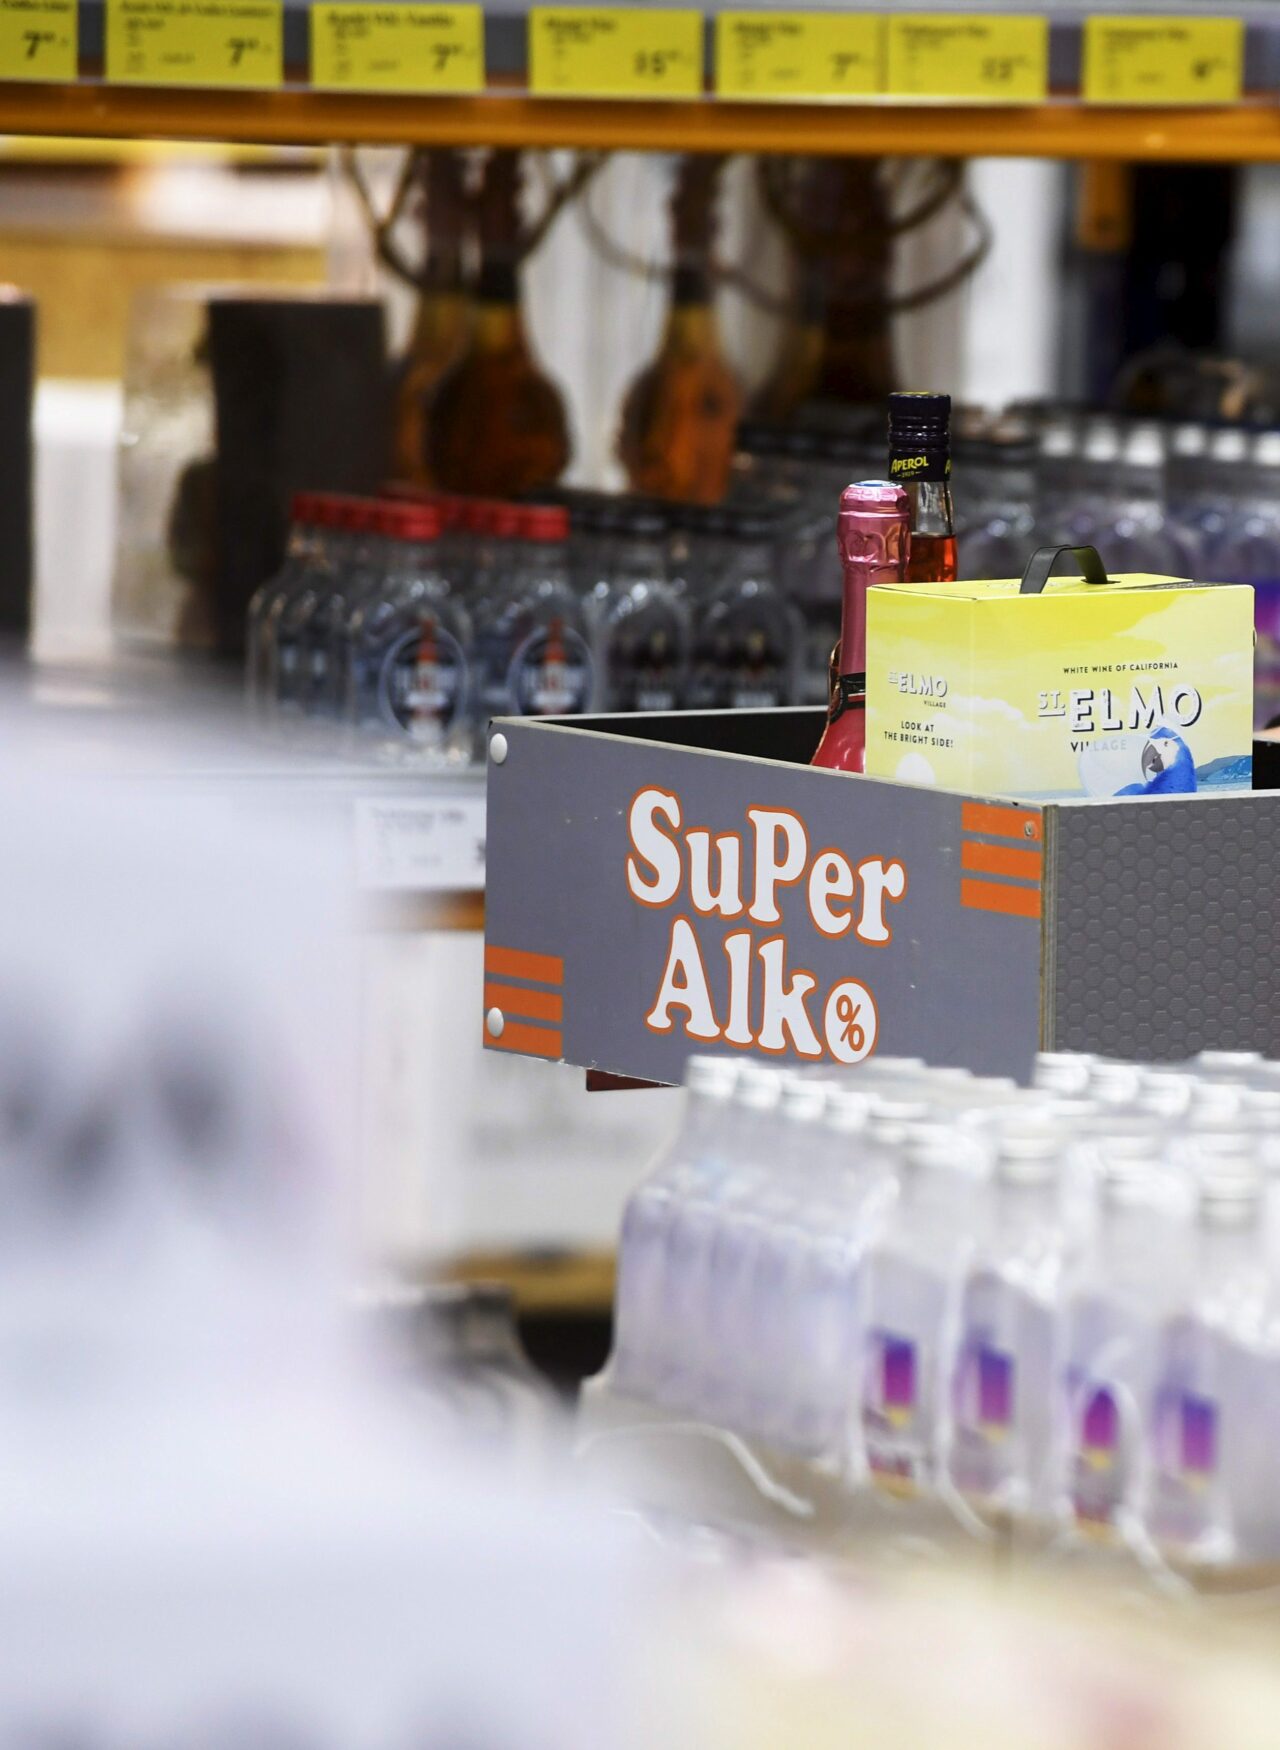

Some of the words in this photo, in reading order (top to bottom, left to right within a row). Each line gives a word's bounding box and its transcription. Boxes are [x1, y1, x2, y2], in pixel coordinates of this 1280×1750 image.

[891, 456, 929, 474] APEROL
[1063, 666, 1088, 674] WHITE
[1092, 665, 1113, 673] WINE
[1129, 662, 1179, 671] CALIFORNIA
[899, 671, 948, 698] ELMO
[1070, 684, 1202, 733] ELMO
[901, 720, 921, 731] LOOK
[924, 724, 935, 732] AT
[884, 731, 898, 741] THE
[900, 733, 928, 744] BRIGHT
[931, 737, 954, 748] SIDE!
